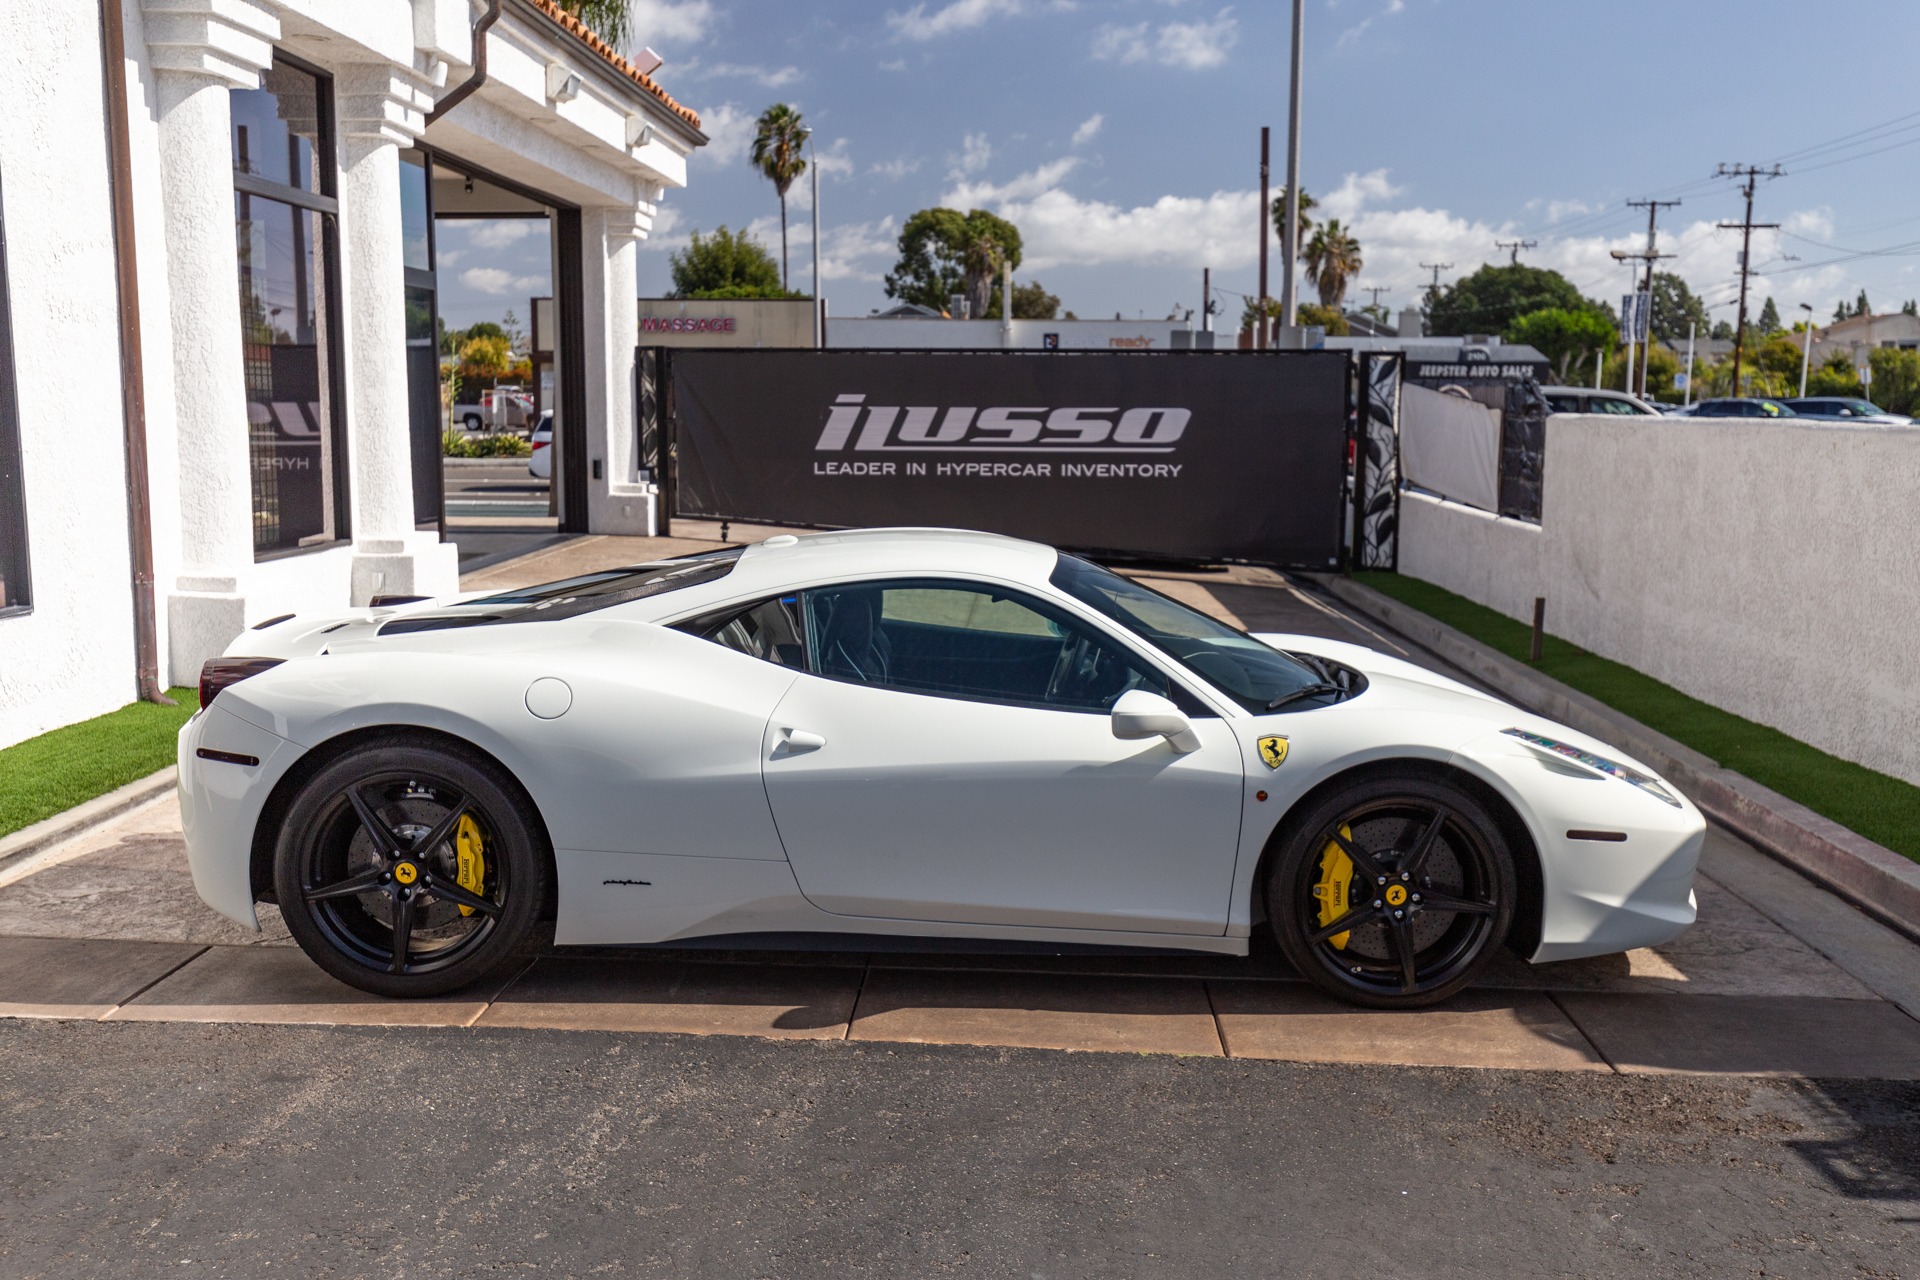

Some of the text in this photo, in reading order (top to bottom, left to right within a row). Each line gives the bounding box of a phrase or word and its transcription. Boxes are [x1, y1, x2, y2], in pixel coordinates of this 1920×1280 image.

[642, 317, 736, 332] MASSAGE
[1419, 364, 1468, 377] JEEPSTER
[1469, 364, 1500, 377] AUTO
[813, 462, 1182, 477] LEADER IN HYPERCAR INVENTORY
